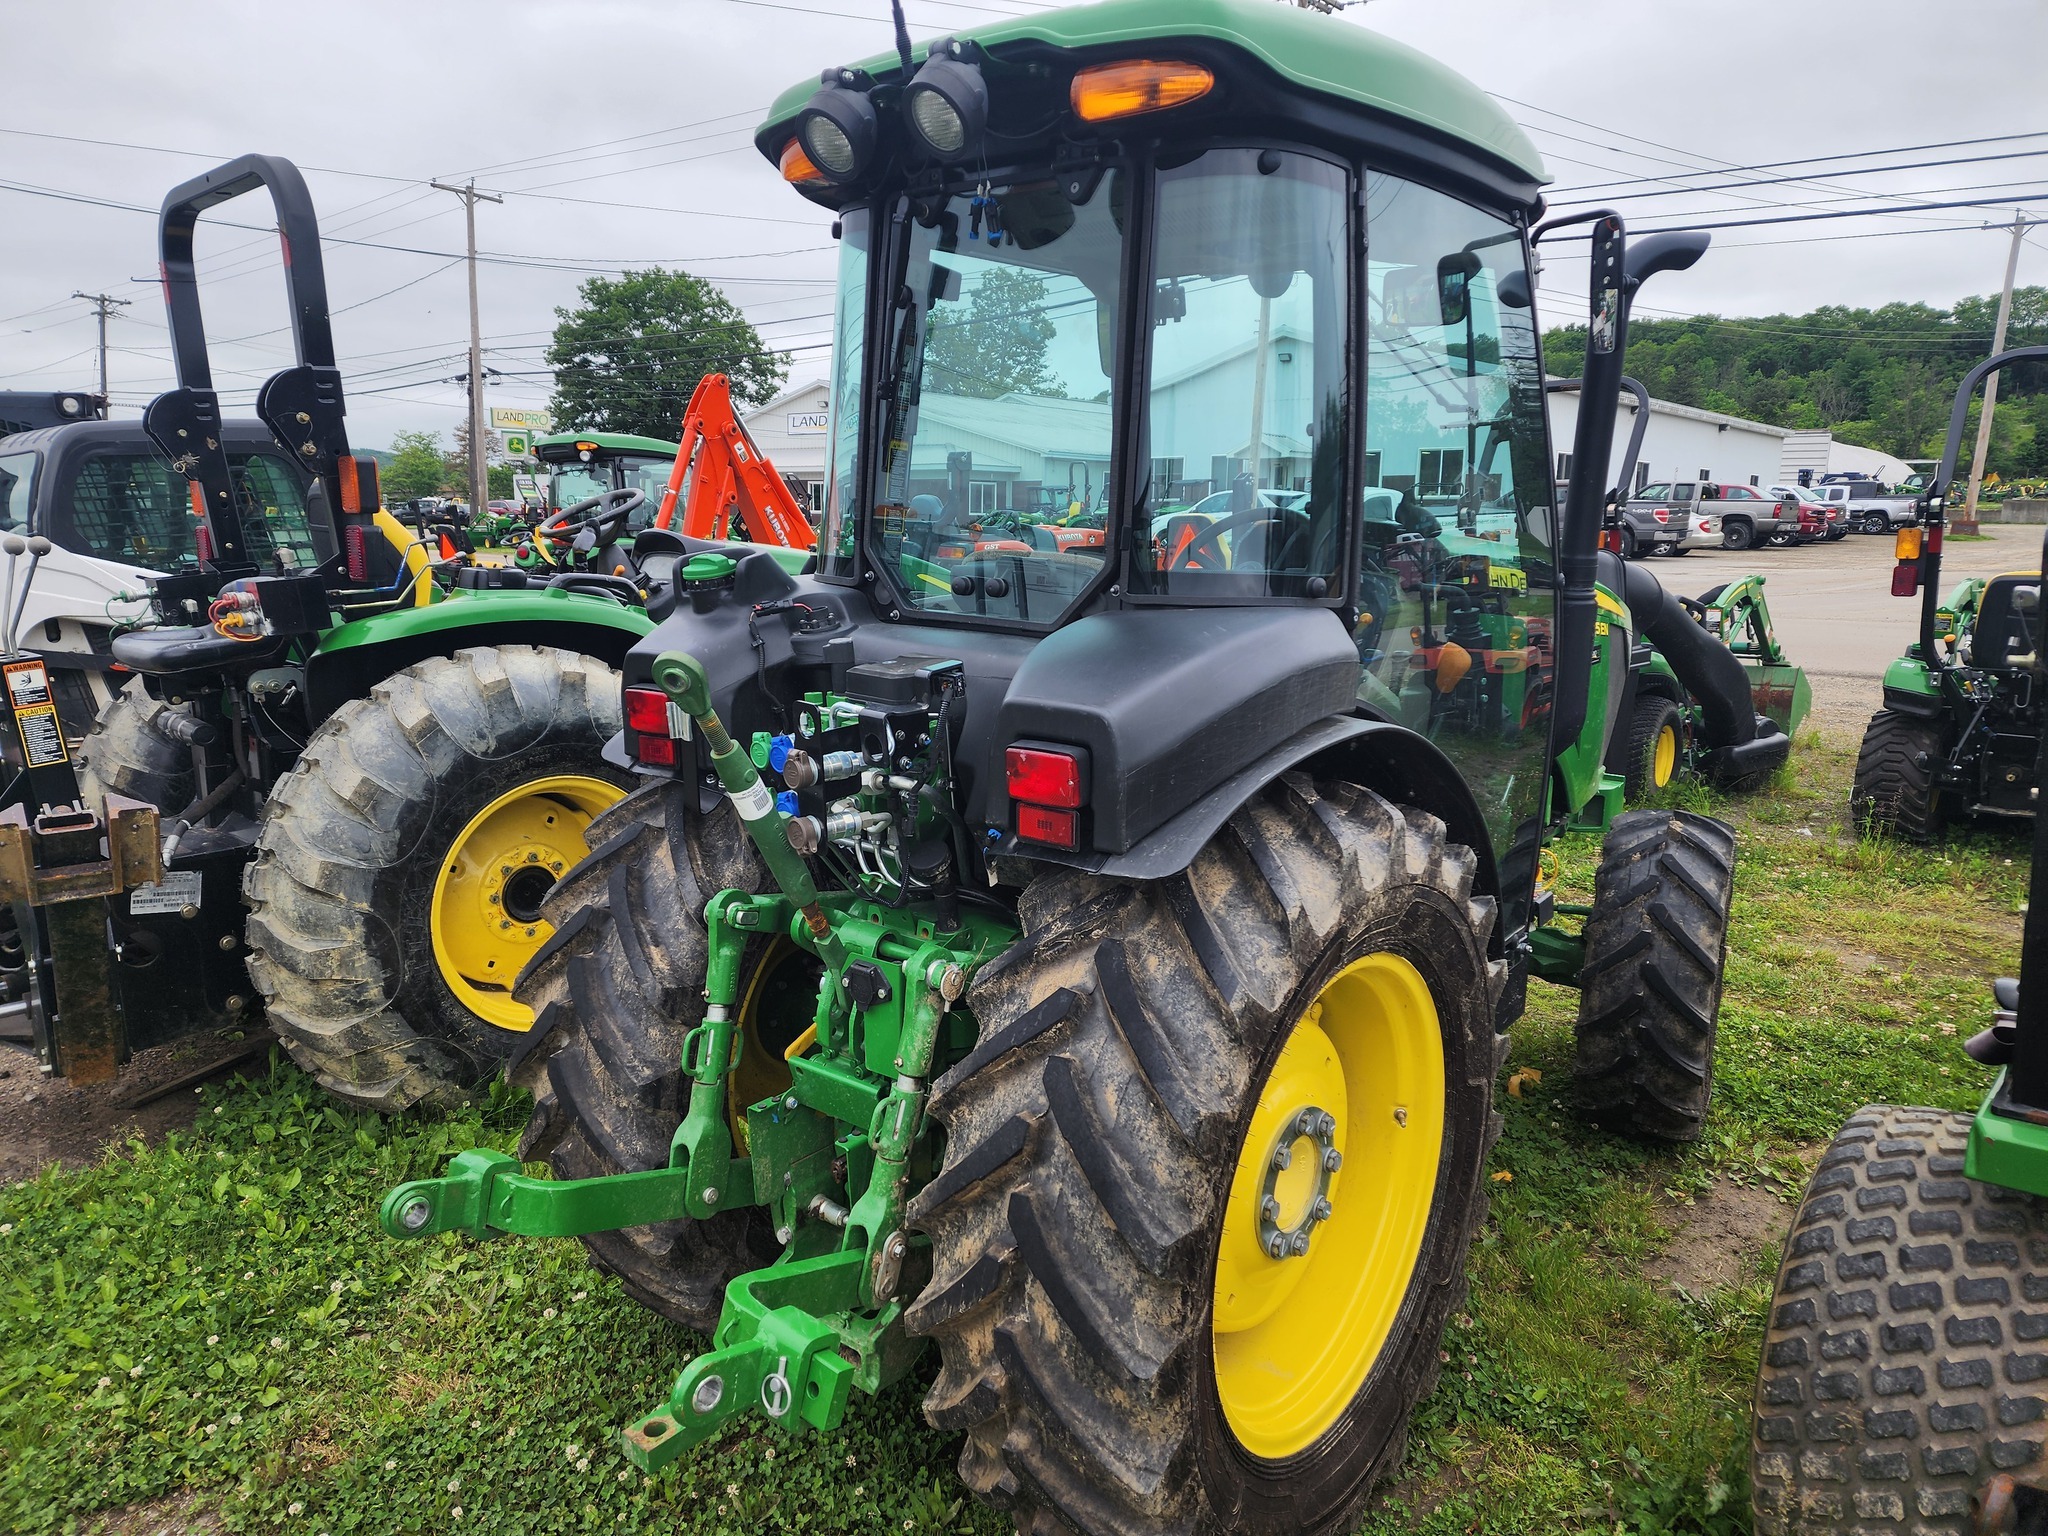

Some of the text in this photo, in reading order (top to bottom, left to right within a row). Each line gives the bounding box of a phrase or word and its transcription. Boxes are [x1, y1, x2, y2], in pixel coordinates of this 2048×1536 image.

[497, 411, 549, 426] LANDPRO
[792, 415, 828, 428] LAND
[1056, 532, 1083, 542] KUBOTA
[12, 661, 43, 671] WARNING
[25, 705, 53, 716] CAUTION
